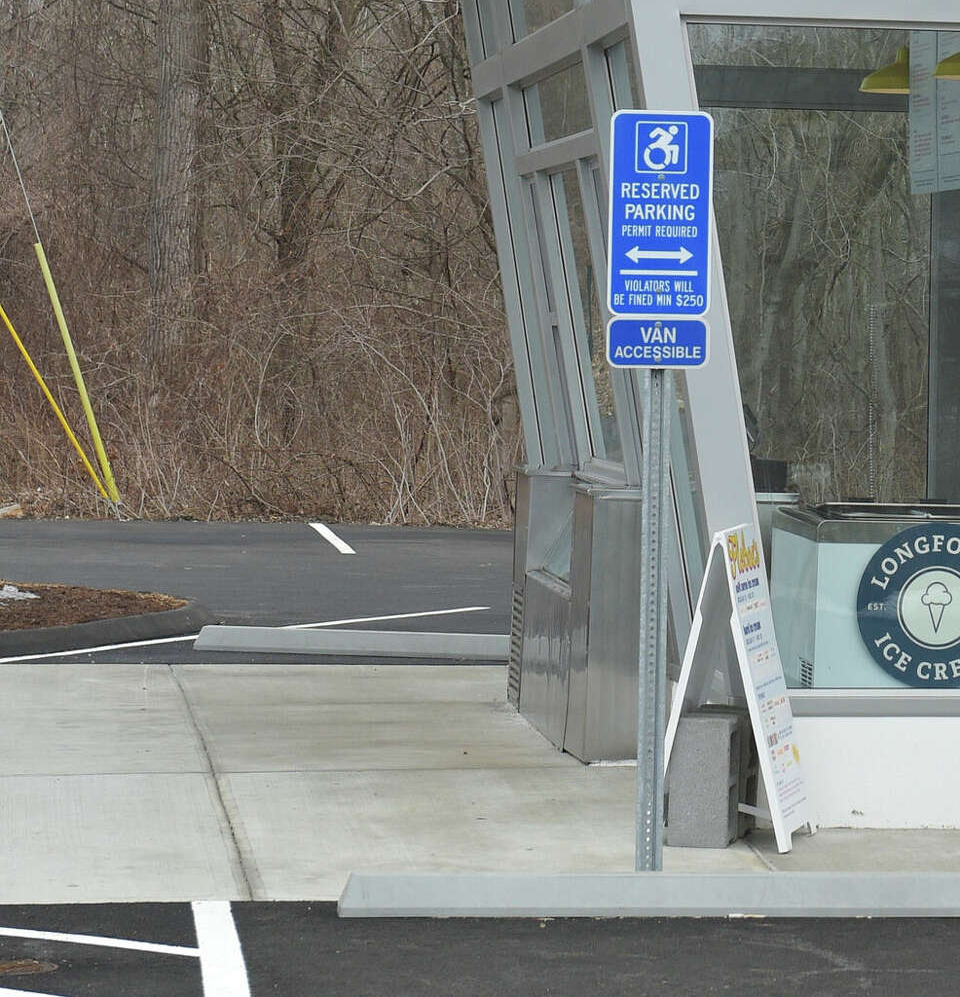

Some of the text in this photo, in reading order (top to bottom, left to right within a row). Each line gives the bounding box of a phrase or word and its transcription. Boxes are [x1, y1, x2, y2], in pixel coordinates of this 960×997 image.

[621, 182, 700, 199] RESERVED
[625, 204, 695, 221] PARKING
[622, 225, 698, 238] PERMIT REQUIRED
[624, 280, 694, 293] VIOLATORS WILL
[614, 294, 704, 307] BE FINED MIN $250
[640, 326, 677, 344] VAN
[614, 346, 701, 359] ACCESSIBLE
[874, 632, 912, 672] ICE
